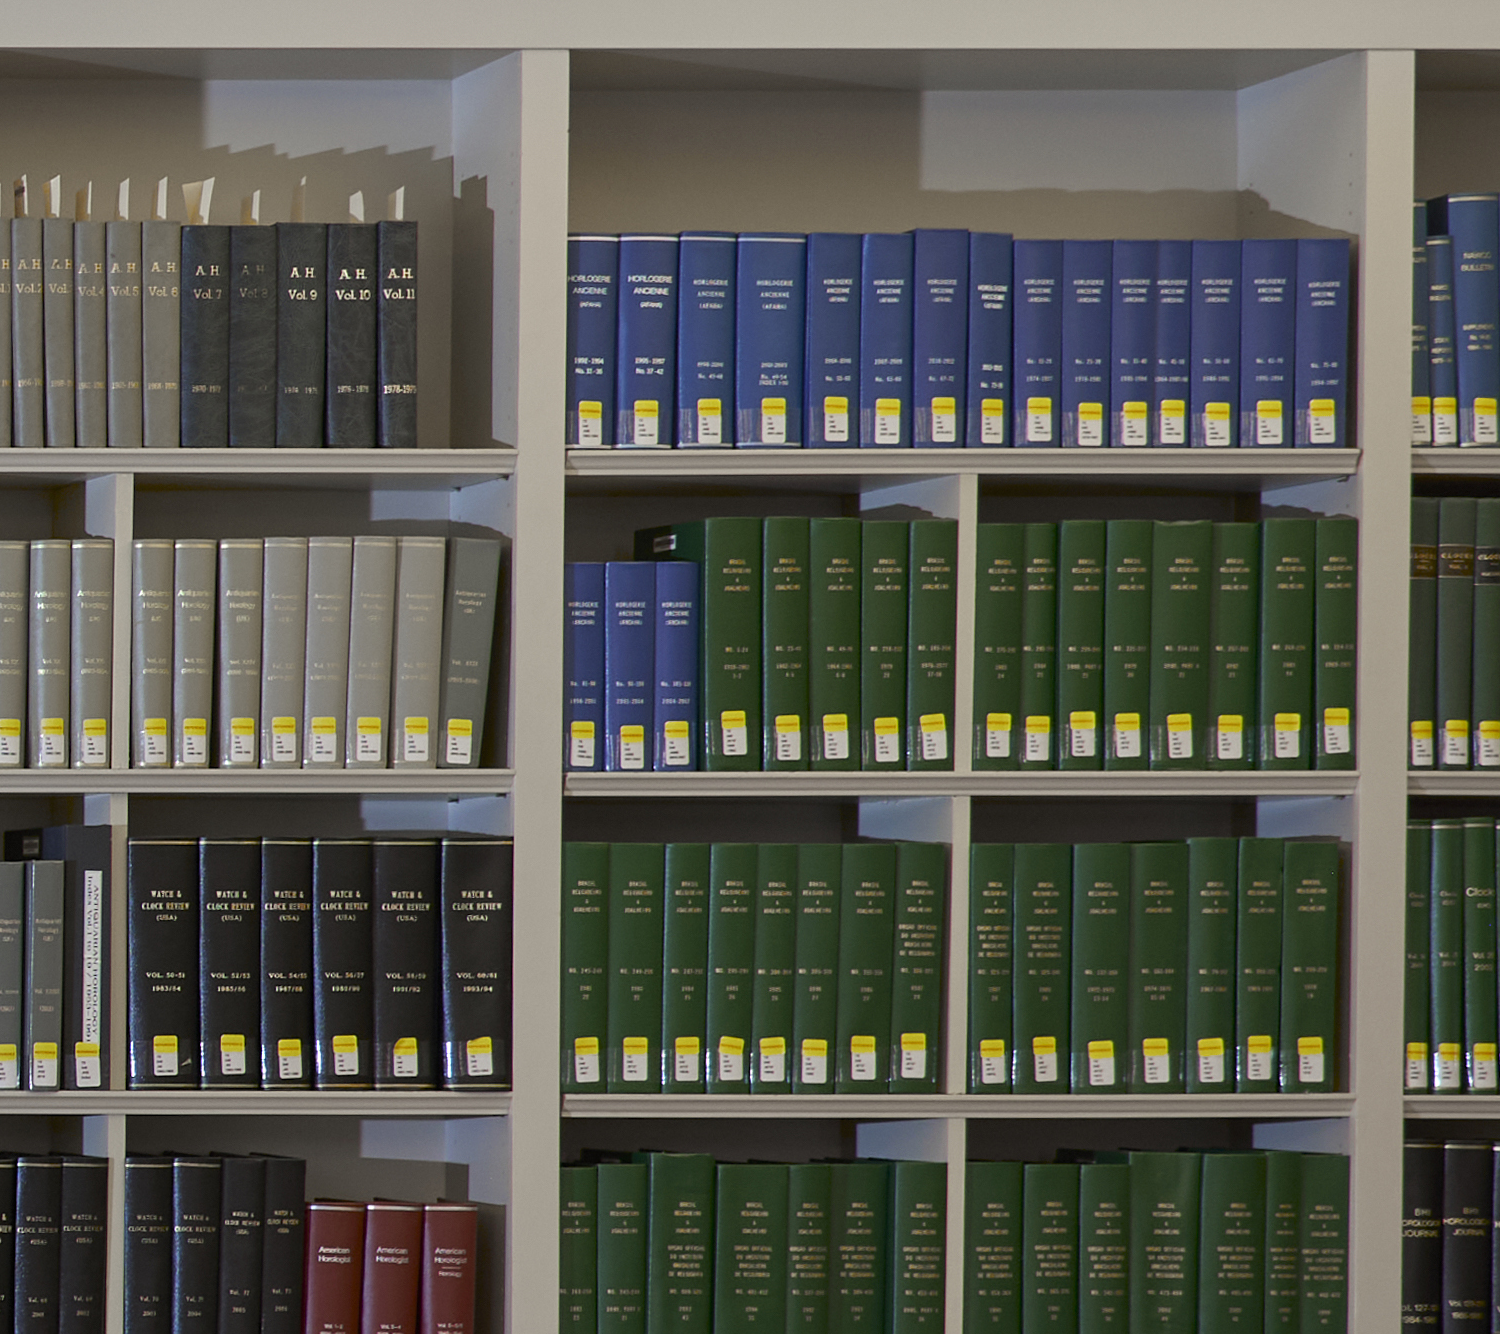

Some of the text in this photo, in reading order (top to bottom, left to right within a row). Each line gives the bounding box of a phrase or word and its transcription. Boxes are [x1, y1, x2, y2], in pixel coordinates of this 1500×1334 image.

[290, 267, 316, 278] A. H.
[339, 269, 367, 280] A. H.
[387, 268, 413, 279] A. H.
[151, 890, 173, 898] WATCH
[461, 890, 484, 898] WATCH
[141, 902, 163, 910] CLOCK
[453, 902, 474, 910] CLOCK
[86, 940, 92, 951] to
